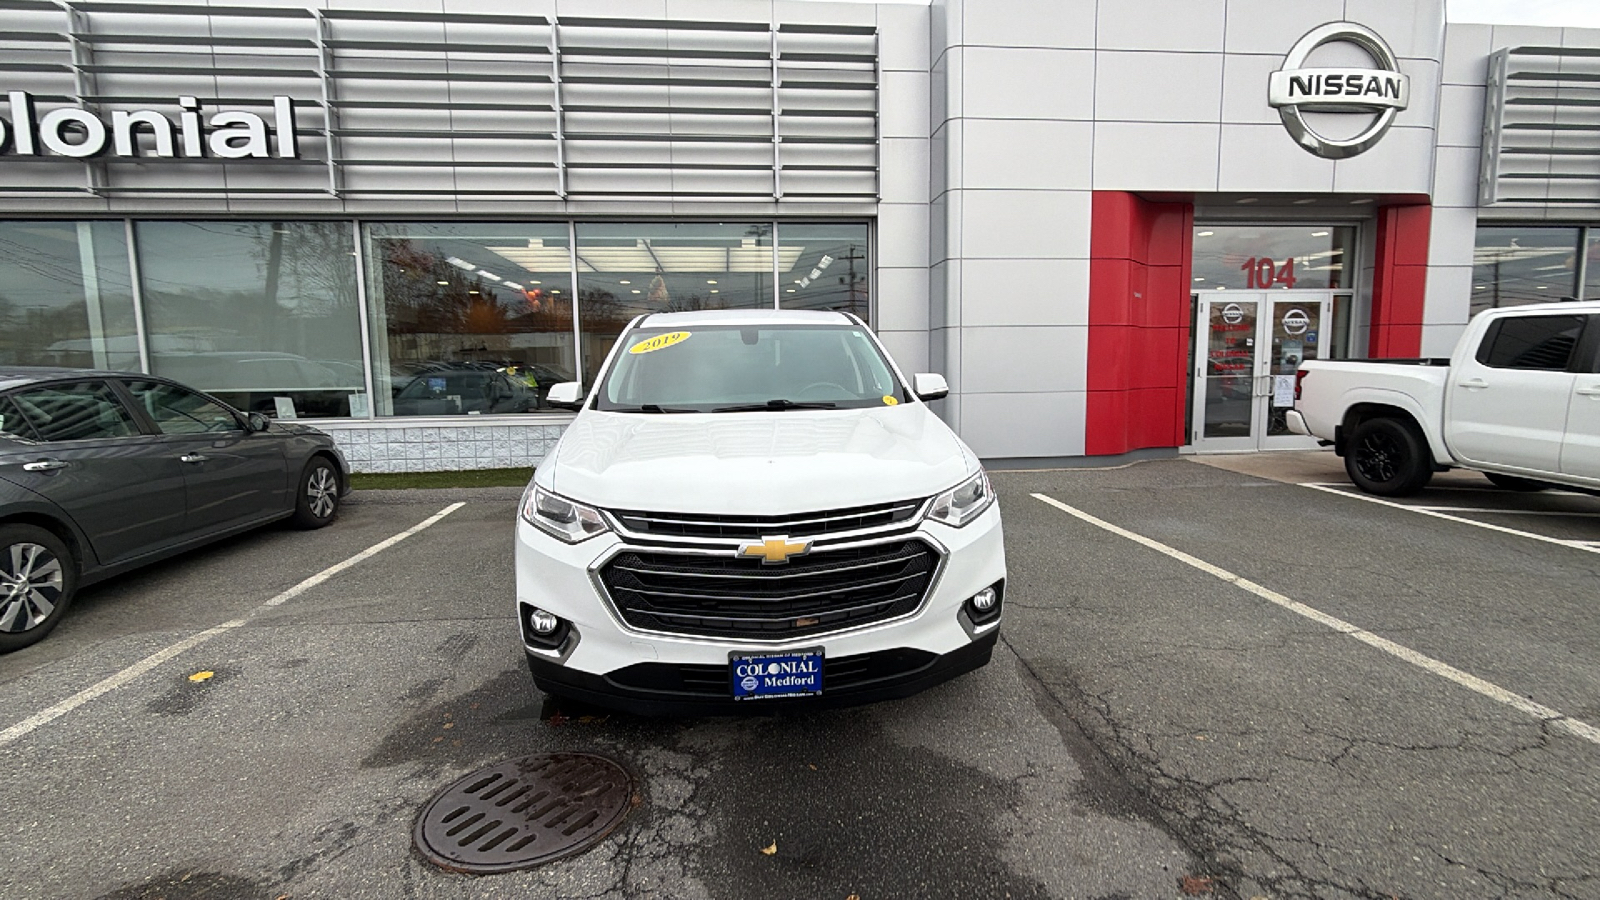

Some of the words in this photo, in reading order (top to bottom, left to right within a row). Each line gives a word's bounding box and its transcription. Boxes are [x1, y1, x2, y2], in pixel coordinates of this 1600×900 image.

[1288, 74, 1402, 99] NISSAN
[0, 90, 297, 158] lonial
[1241, 257, 1297, 289] 104
[643, 333, 681, 351] 2019
[736, 661, 819, 678] COLONIAL
[764, 675, 815, 688] Medford
